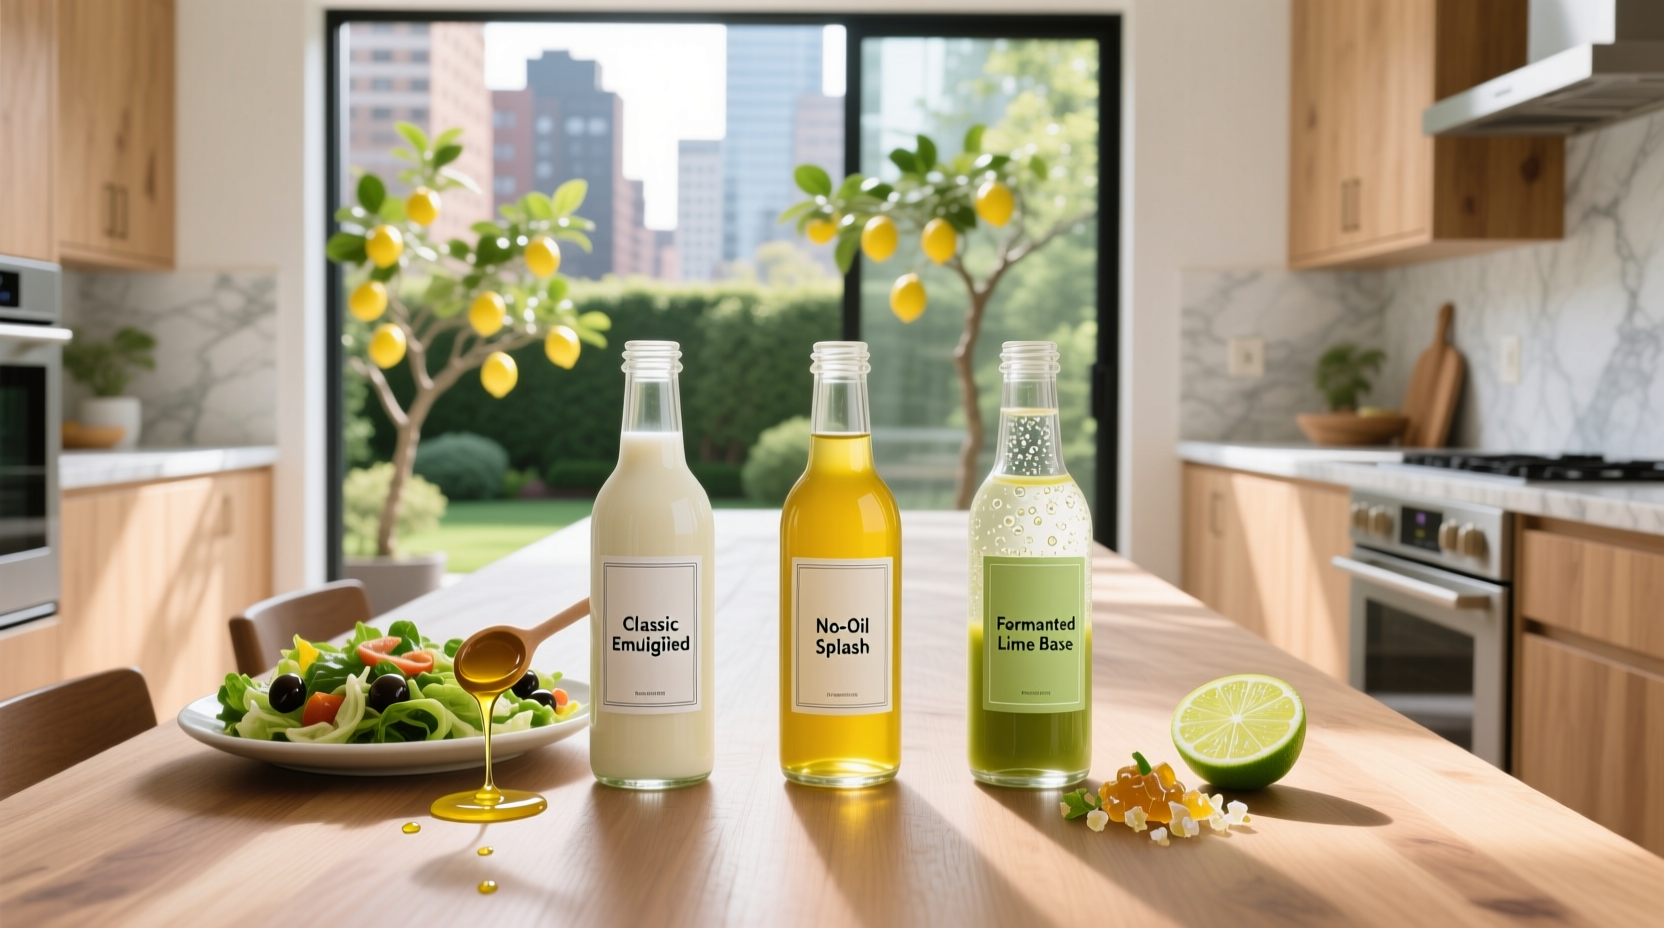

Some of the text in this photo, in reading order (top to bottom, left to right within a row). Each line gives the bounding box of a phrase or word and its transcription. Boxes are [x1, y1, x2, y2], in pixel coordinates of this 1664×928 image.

[623, 616, 679, 632] Classic
[816, 617, 869, 634] No-Oil
[997, 616, 1075, 631] Formanted
[816, 637, 870, 658] Splash
[998, 636, 1074, 651] Lime Base
